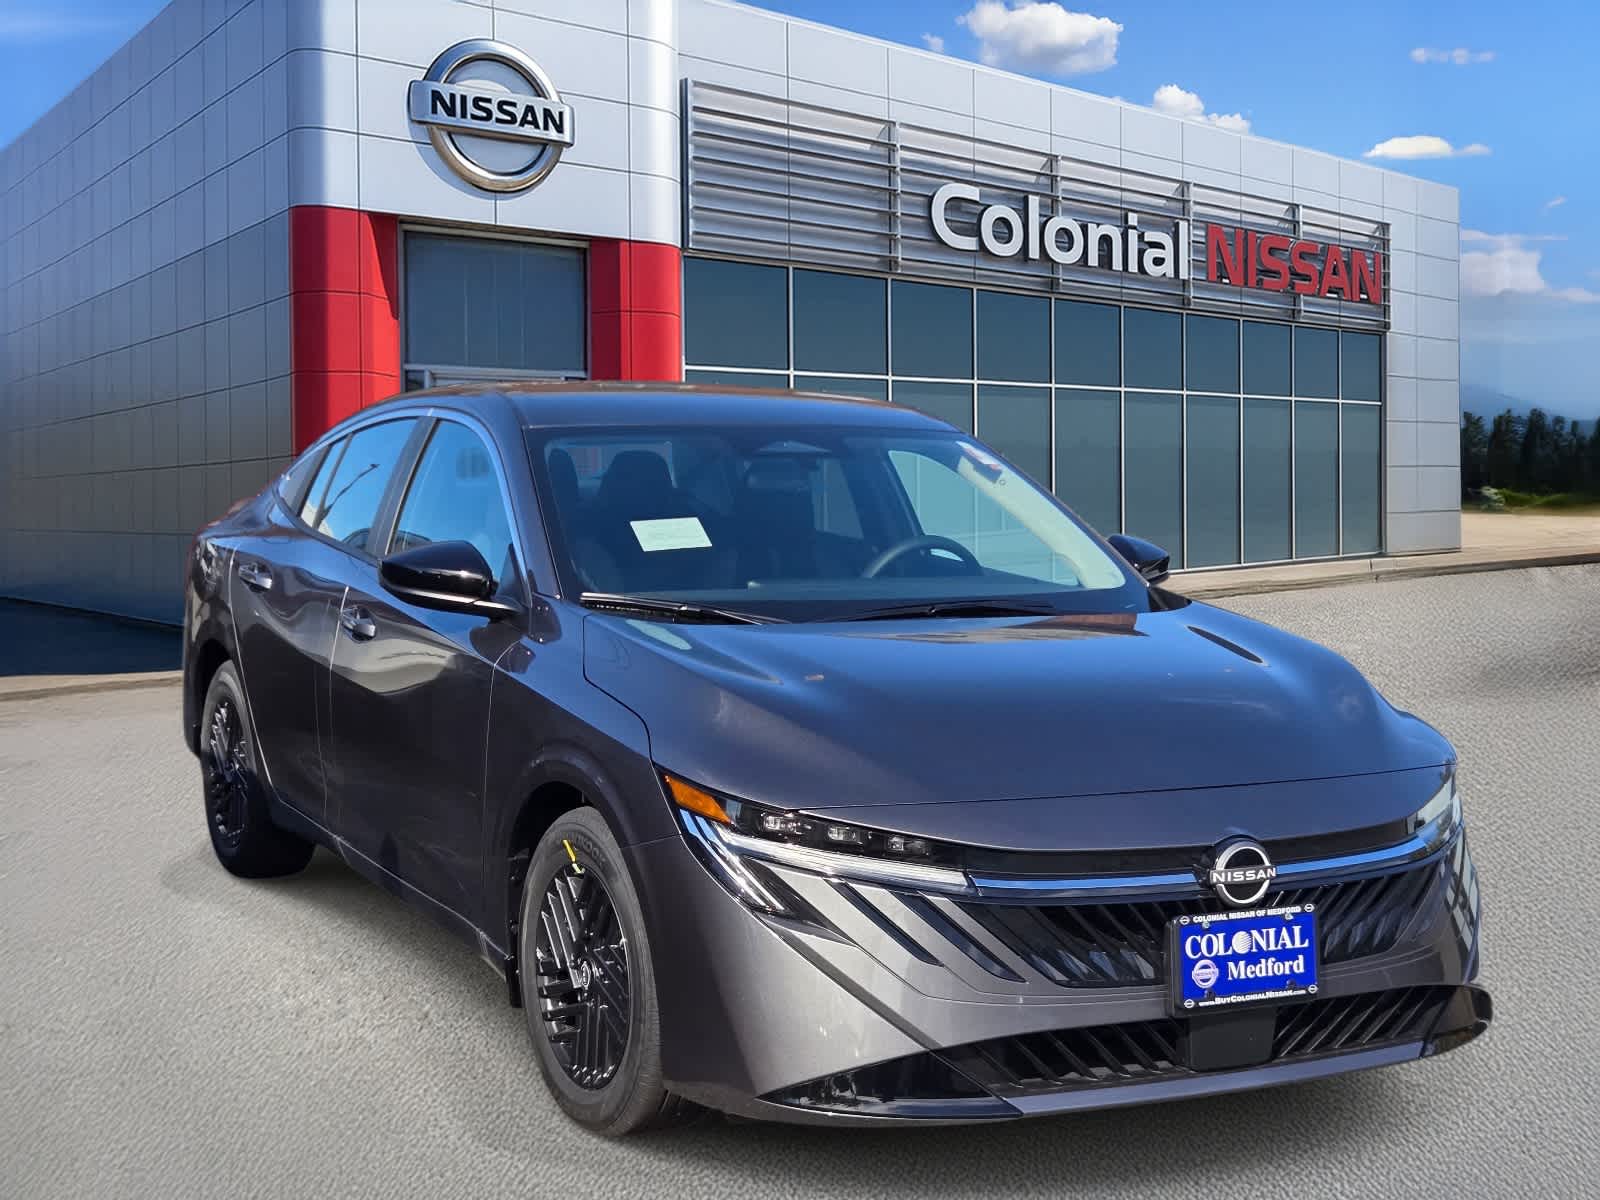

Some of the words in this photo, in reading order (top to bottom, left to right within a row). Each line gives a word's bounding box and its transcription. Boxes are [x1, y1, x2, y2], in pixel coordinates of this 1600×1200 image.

[430, 89, 565, 135] NISSAN
[930, 182, 1189, 281] Colonial
[1206, 224, 1381, 304] NISSAN
[1212, 867, 1276, 882] NISSAN
[1193, 913, 1228, 923] COLONIAL
[1256, 909, 1267, 917] OF
[1185, 925, 1310, 959] COLONIAL
[1227, 955, 1305, 981] Medford
